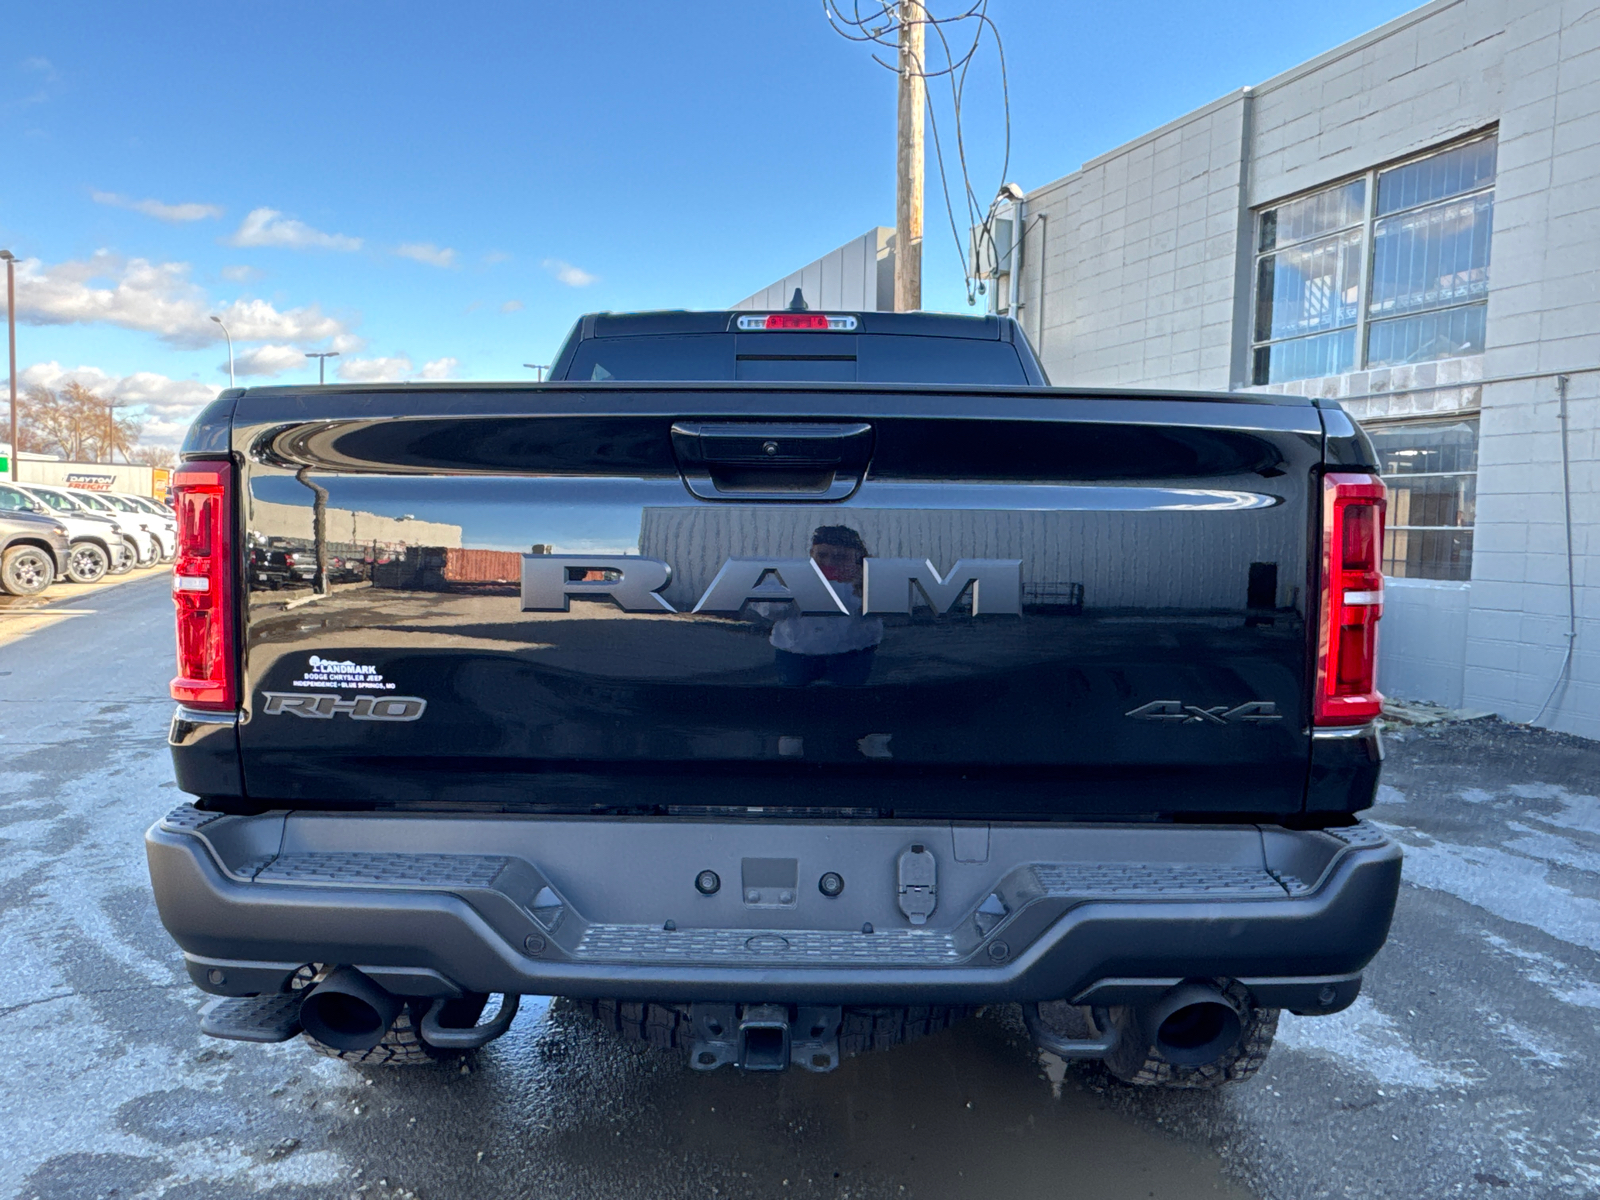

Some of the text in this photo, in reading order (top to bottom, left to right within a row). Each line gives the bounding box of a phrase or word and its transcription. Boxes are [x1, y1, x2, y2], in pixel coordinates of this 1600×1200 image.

[68, 482, 111, 490] FREIGHT
[521, 554, 1022, 617] RAM
[320, 665, 376, 675] LANDMARK
[329, 673, 364, 682] CHRYSLER
[262, 691, 427, 722] RHO
